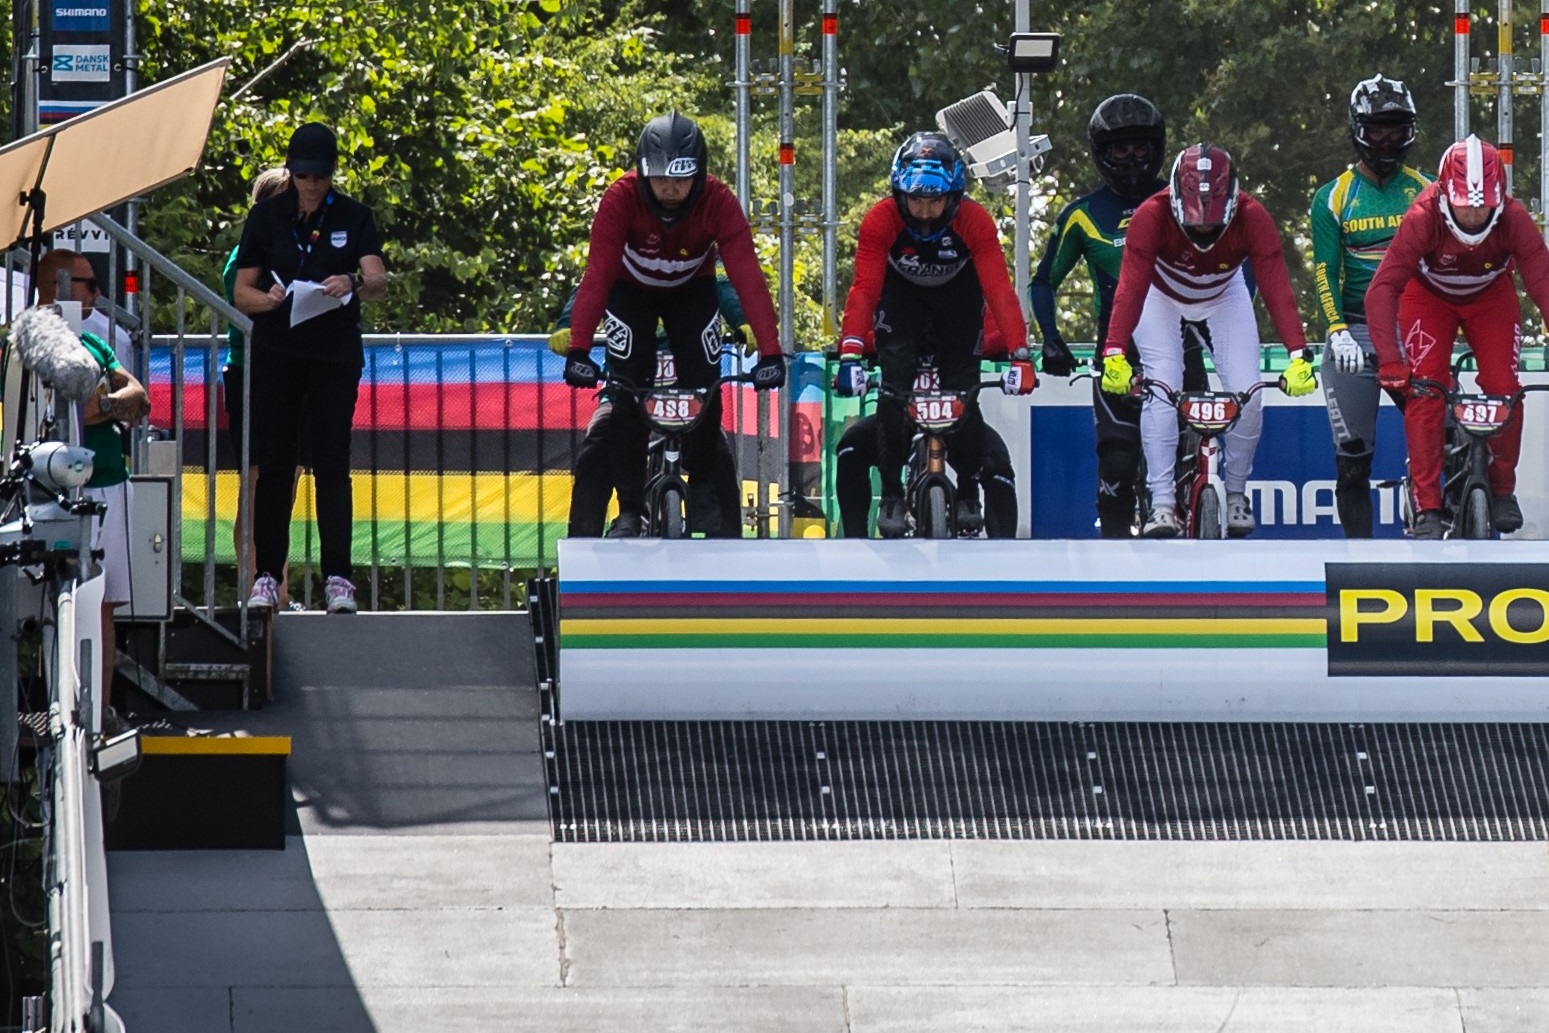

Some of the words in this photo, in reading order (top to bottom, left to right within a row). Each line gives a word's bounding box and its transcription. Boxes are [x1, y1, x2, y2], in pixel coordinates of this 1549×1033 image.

[55, 8, 107, 17] SHIMANO
[75, 55, 109, 64] DANSK
[75, 64, 108, 72] METAL
[1343, 216, 1384, 233] SOUTH
[1316, 262, 1328, 293] SOUTH
[917, 402, 953, 419] 504
[1189, 402, 1225, 420] 496
[1463, 405, 1497, 423] 497
